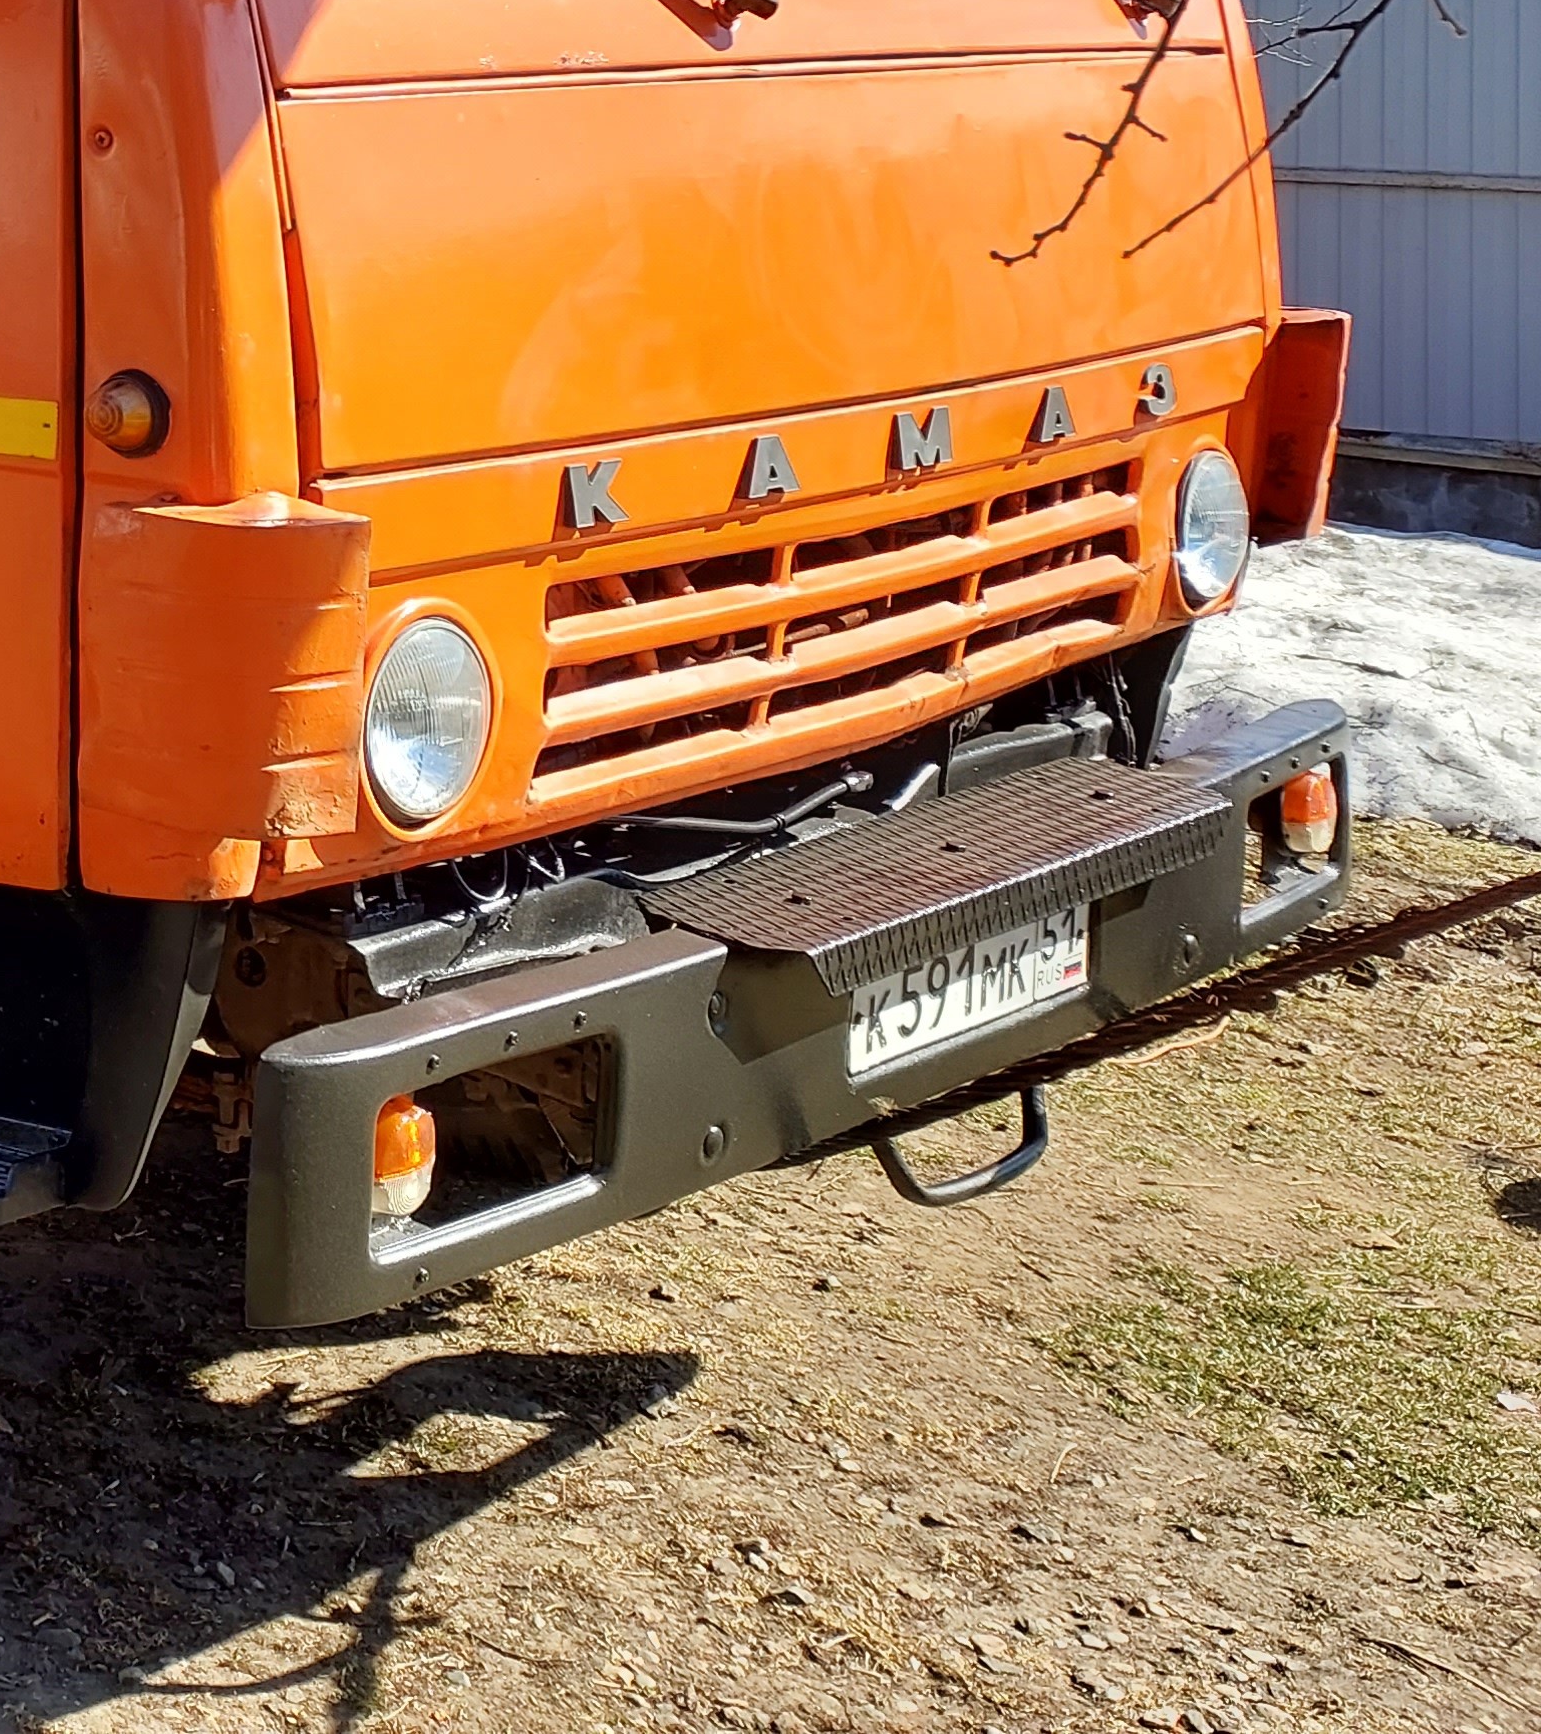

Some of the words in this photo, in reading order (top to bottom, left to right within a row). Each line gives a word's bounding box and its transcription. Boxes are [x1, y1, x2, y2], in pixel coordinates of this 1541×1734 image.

[566, 363, 1177, 528] КАМАЗ
[865, 938, 1030, 1054] К591МК
[1036, 962, 1062, 988] RUS
